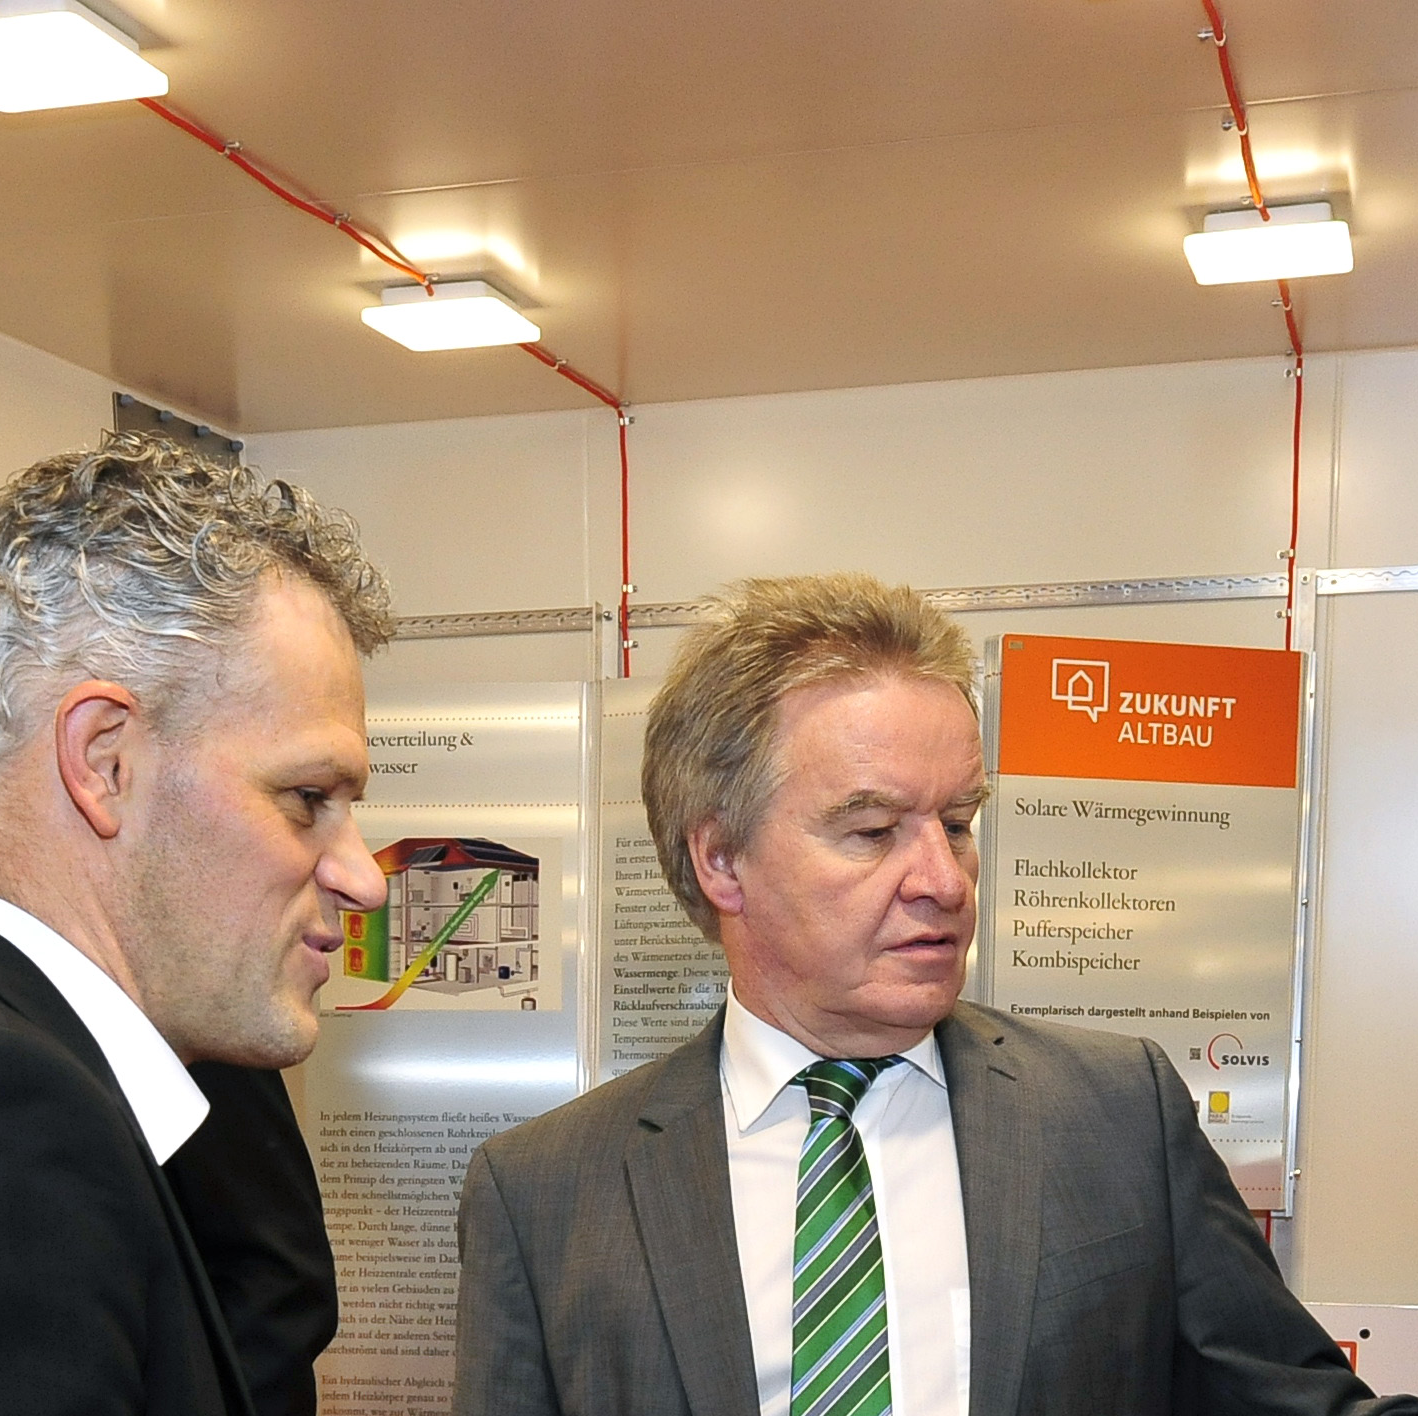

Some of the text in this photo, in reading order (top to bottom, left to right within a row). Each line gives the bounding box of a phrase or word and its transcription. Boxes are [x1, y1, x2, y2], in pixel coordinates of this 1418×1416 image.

[1118, 692, 1237, 719] ZUKUNFT
[460, 732, 473, 746] &
[1117, 721, 1213, 747] ALTBAU
[369, 762, 418, 774] wasser
[1014, 797, 1231, 830] Solare Wärmegewinnung
[615, 837, 655, 848] Für eine
[1014, 858, 1138, 881] Flachkollektor
[1013, 889, 1176, 912] Röhrenkollektoren
[1013, 919, 1133, 945] Pufferspeicher
[1011, 949, 1141, 976] Kombispeicher
[683, 967, 709, 977] Diese
[613, 983, 710, 995] Einstellwerte für die
[613, 999, 719, 1011] Rücklaufverschraubun
[1010, 1004, 1271, 1021] Exemplarisch dargestellt anhand Beispielen von
[1221, 1054, 1270, 1066] SOLVIS
[320, 1112, 330, 1121] In
[332, 1112, 361, 1122] jedem
[364, 1112, 439, 1124] Heizungssystem
[441, 1112, 466, 1122] fließt
[469, 1113, 499, 1123] heißes
[320, 1127, 497, 1141] durch einen geschlossenen Rohrkreisl
[320, 1144, 338, 1153] sich
[341, 1144, 350, 1153] in
[353, 1143, 370, 1153] den
[374, 1143, 432, 1156] Heizkörpern
[449, 1144, 467, 1154] und
[320, 1159, 335, 1168] die
[351, 1159, 410, 1169] beheizenden
[320, 1174, 445, 1187] dem Prinzip des geringsten
[341, 1189, 359, 1199] den
[362, 1189, 450, 1202] schnellstmöglichen
[324, 1206, 372, 1217] angspunkt
[384, 1206, 400, 1215] der
[358, 1221, 387, 1231] Durch
[420, 1222, 451, 1232] dünne
[348, 1237, 435, 1248] weniger Wasser als
[356, 1252, 436, 1265] beispielsweise im
[340, 1267, 456, 1279] der Heizzentrale entfernt
[349, 1284, 455, 1294] in vielen Gebäuden zu
[342, 1299, 435, 1312] werden nicht richtig
[359, 1314, 367, 1323] in
[370, 1314, 386, 1324] der
[389, 1314, 414, 1324] Nähe
[417, 1315, 432, 1325] der
[358, 1330, 373, 1339] auf
[375, 1330, 390, 1340] der
[393, 1330, 430, 1341] anderen
[324, 1345, 450, 1357] urchströmt und sind daher
